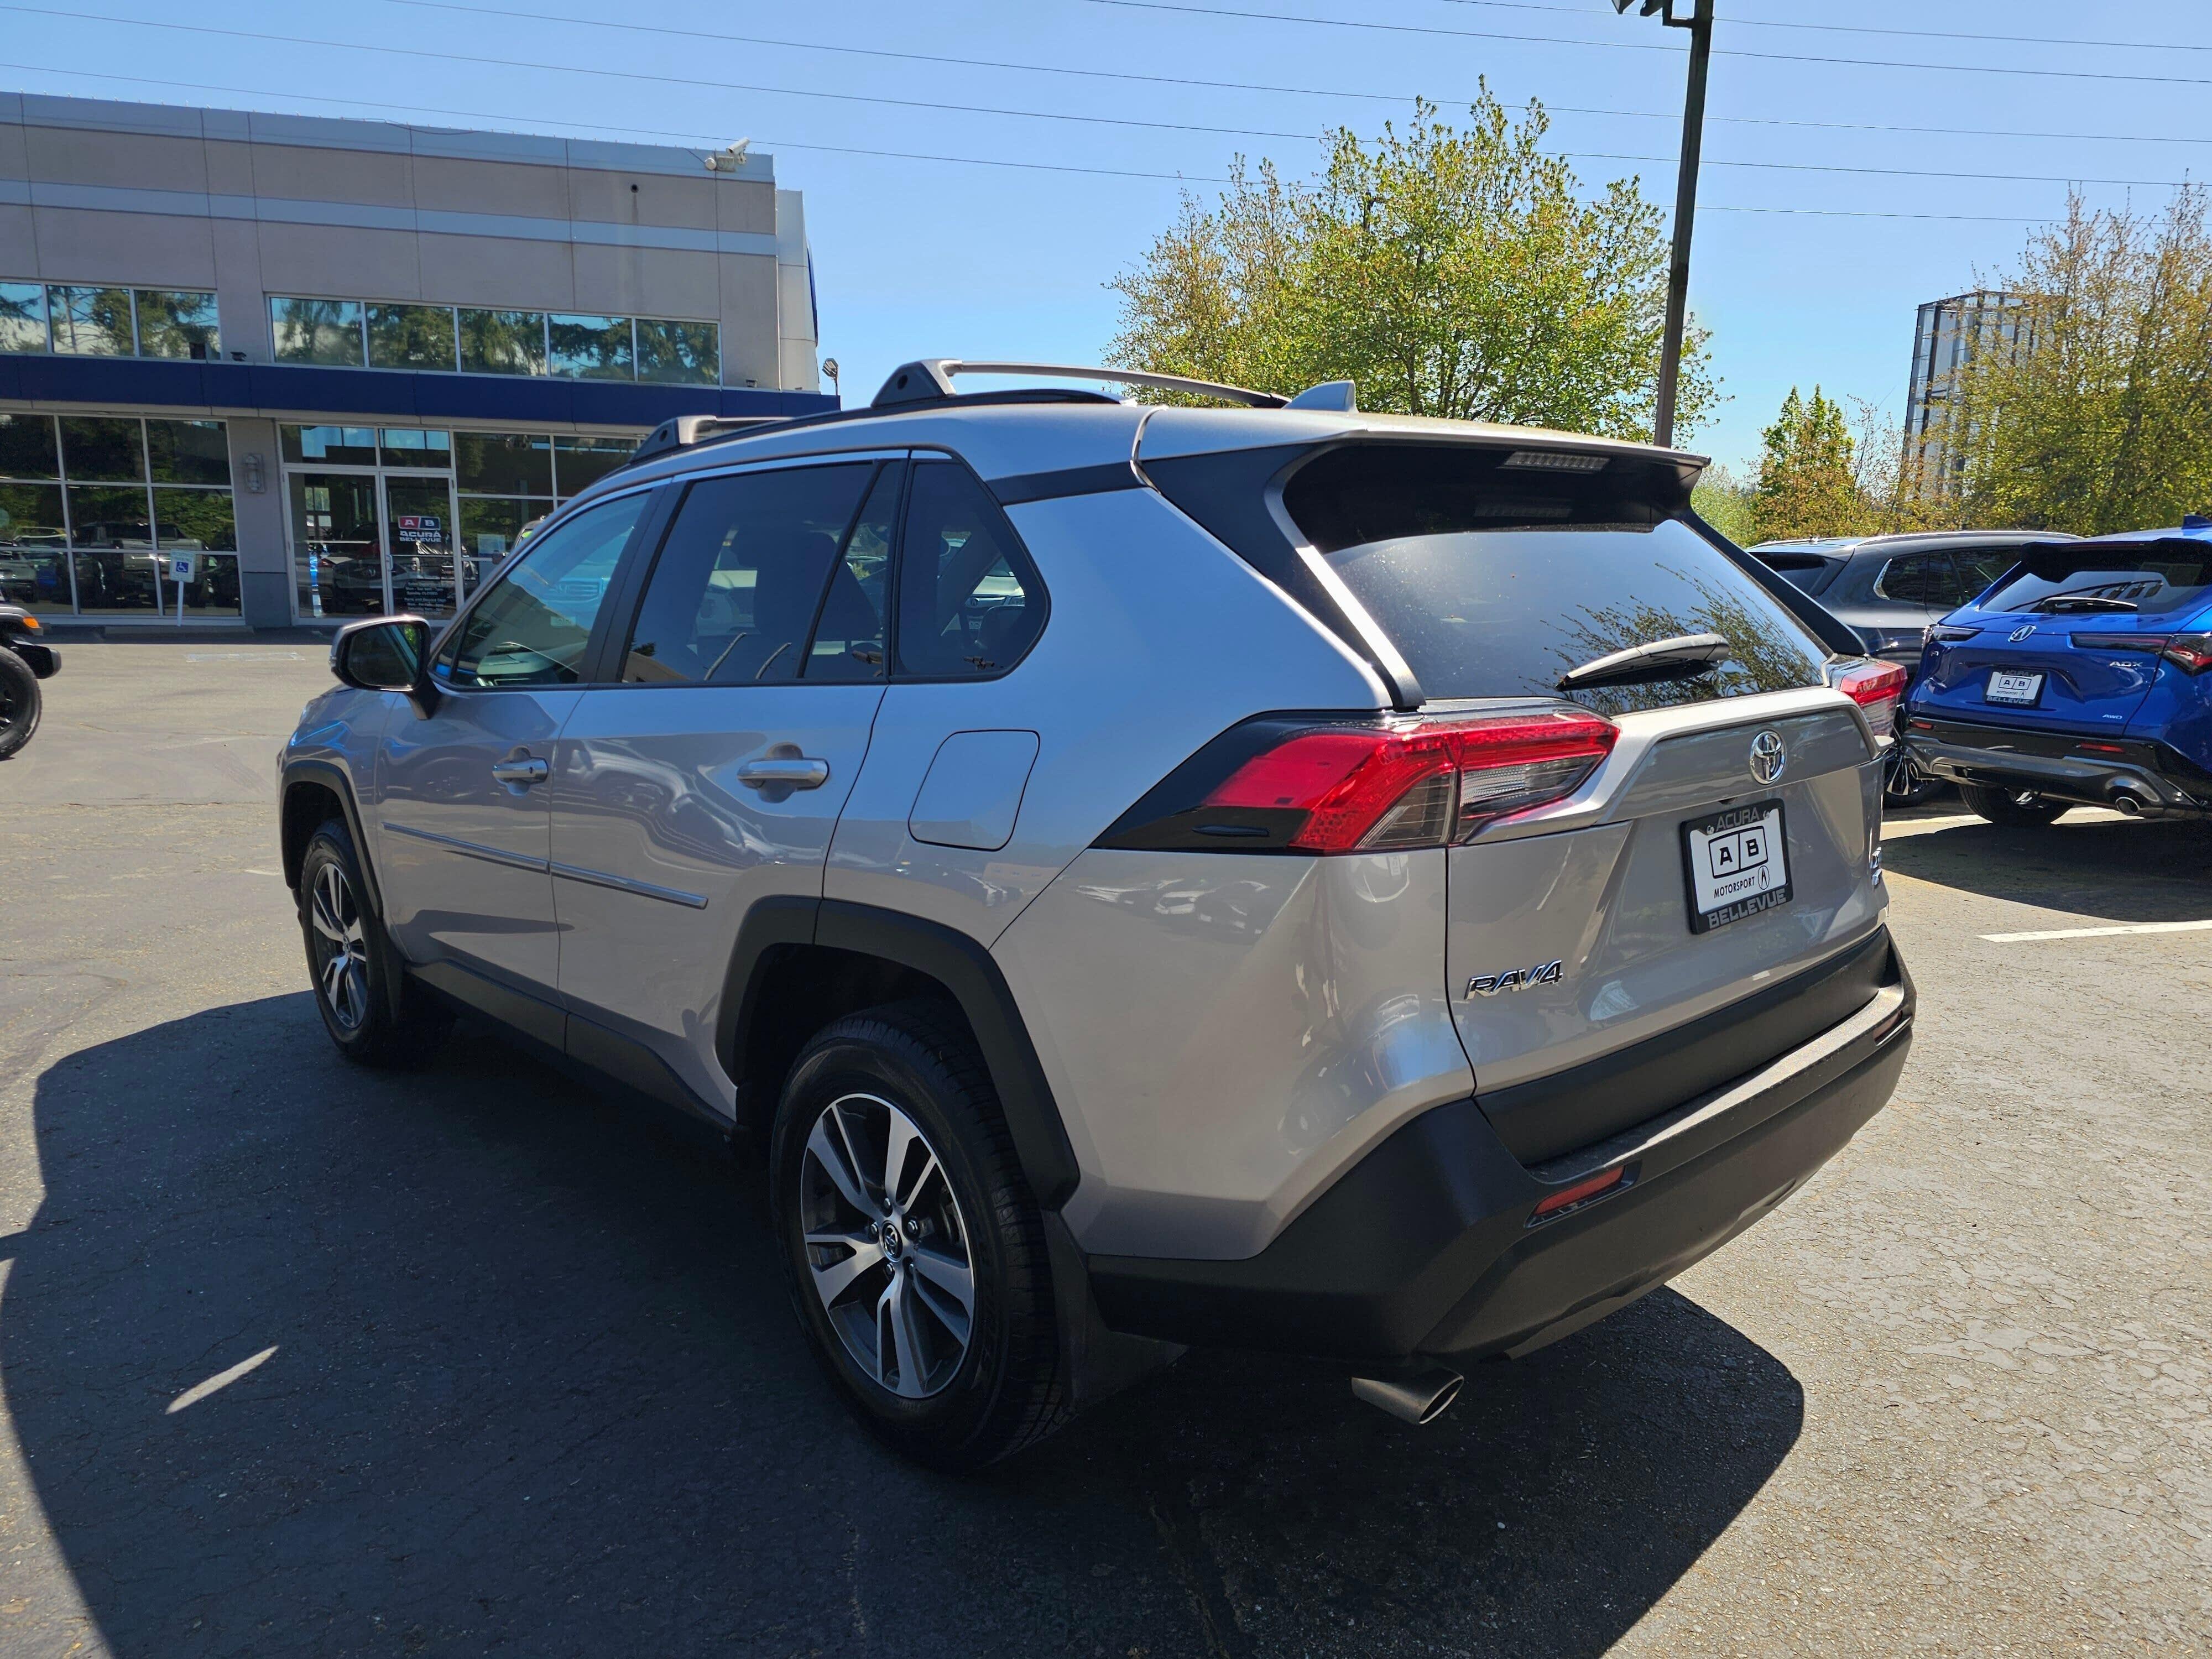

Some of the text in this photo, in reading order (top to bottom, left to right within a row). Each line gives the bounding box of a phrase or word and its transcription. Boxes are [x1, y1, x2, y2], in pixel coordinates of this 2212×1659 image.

[1986, 696, 2031, 705] BELLEVUE
[1716, 807, 1760, 832] ACURA
[1719, 838, 1759, 865] A B
[1714, 876, 1755, 899] MOTORSPORT
[1707, 888, 1787, 929] BELLEVUE
[1464, 959, 1563, 1000] RAV4
